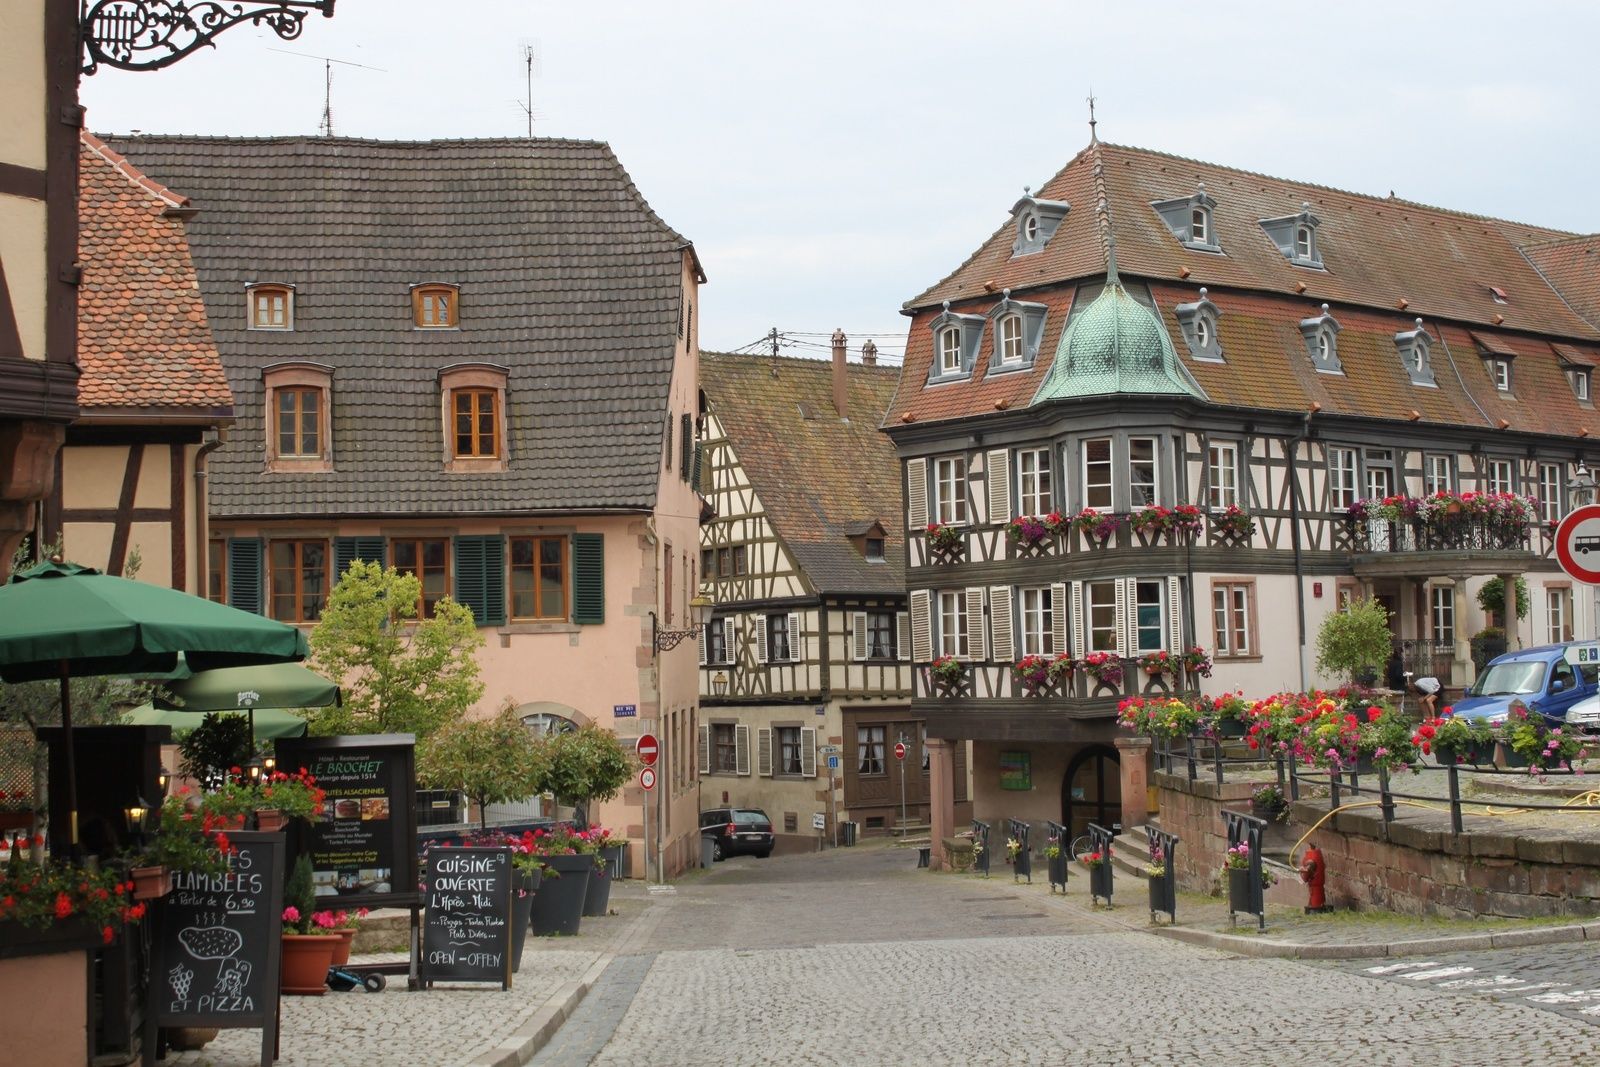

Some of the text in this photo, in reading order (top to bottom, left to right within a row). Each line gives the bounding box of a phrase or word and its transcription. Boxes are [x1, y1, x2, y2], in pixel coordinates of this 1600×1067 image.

[309, 760, 384, 774] LE BROCHET
[315, 774, 339, 782] Auberge
[343, 787, 385, 796] ALSACIENNES
[436, 855, 497, 873] CUISINE
[435, 875, 496, 892] OUVERTE
[207, 895, 217, 906] de
[225, 893, 255, 911] 6,90
[472, 893, 493, 909] Midi
[429, 949, 455, 966] OPEN
[467, 952, 502, 968] OFFEN
[170, 991, 254, 1013] ET PIZZA
